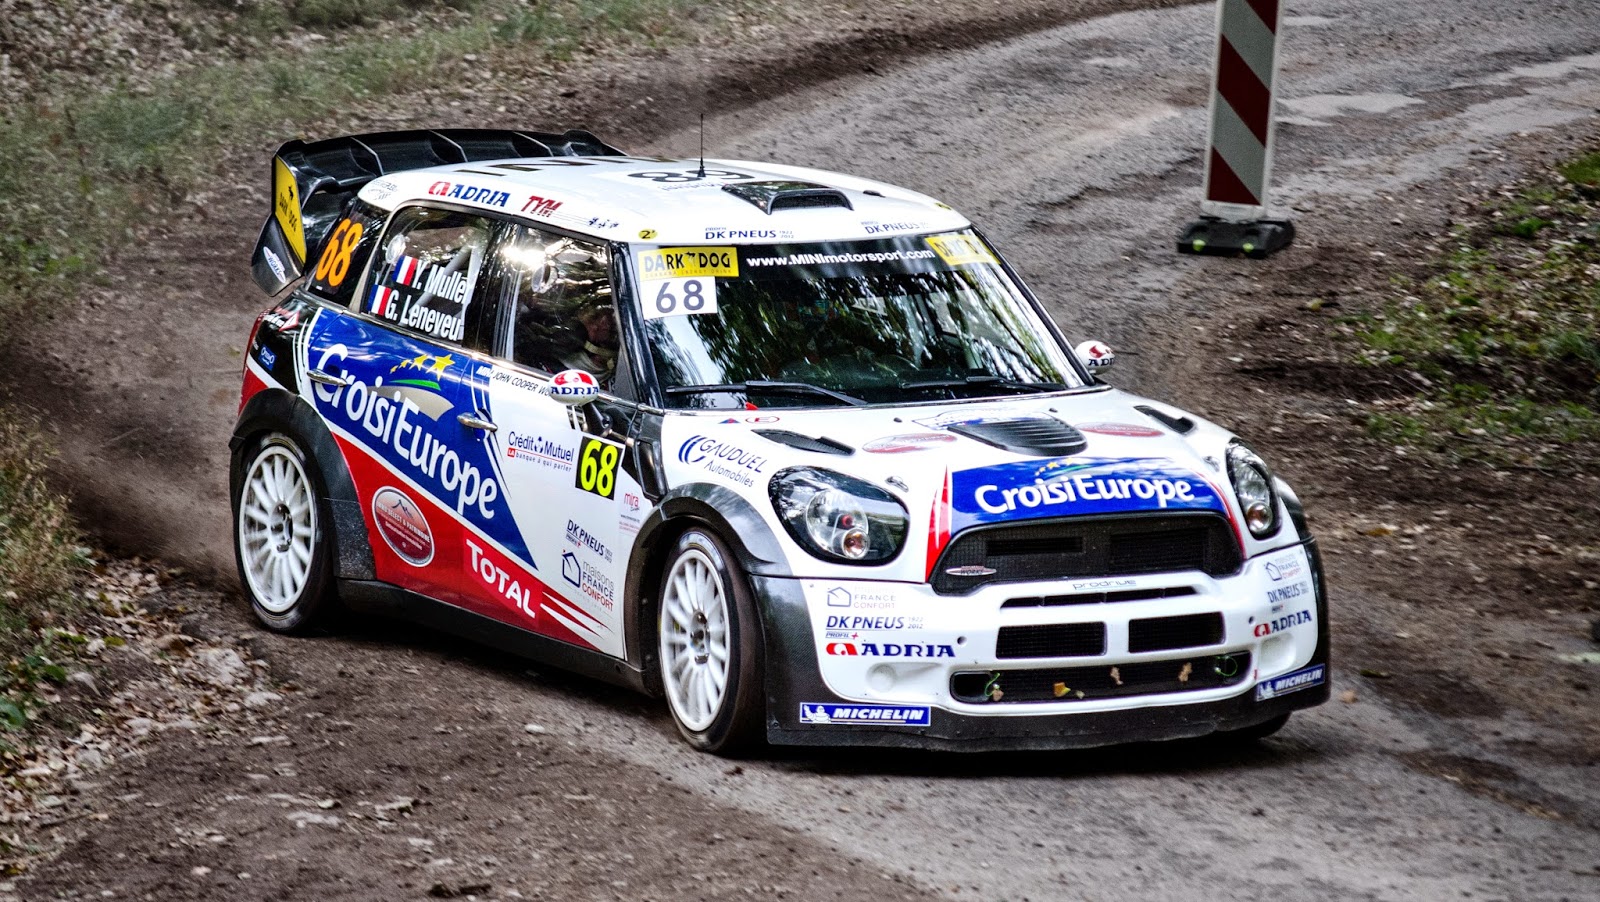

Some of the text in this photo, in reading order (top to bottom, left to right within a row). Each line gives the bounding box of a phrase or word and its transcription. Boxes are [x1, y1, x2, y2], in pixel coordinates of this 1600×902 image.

[447, 184, 511, 207] ADRIA
[521, 195, 563, 214] TYM
[705, 230, 776, 240] DK PNEUS
[864, 225, 884, 234] DK
[882, 221, 920, 231] PNEUS
[316, 218, 363, 287] 68
[644, 252, 731, 273] DARK DOG
[746, 249, 935, 267] www.MINImotorsport.com
[412, 260, 428, 290] Y.
[656, 279, 705, 313] 68
[385, 289, 464, 341] G. Leneveu
[493, 371, 512, 383] JOHN
[511, 377, 539, 392] COOPER
[551, 386, 600, 395] ADRIA
[313, 343, 499, 519] CroisiEurope
[508, 431, 575, 462] Crédit Mutuel
[700, 439, 768, 473] GAUDUEL
[516, 452, 536, 463] banque
[553, 463, 572, 472] parler
[580, 439, 618, 497] 68
[704, 459, 755, 488] Automobiles
[974, 473, 1195, 514] CroisiEurope
[567, 519, 580, 536] DK
[579, 527, 605, 556] PNEUS
[466, 539, 536, 619] TOTAL
[582, 571, 614, 601] FRANCE
[583, 561, 614, 592] maisons
[1073, 579, 1137, 590] prodrive
[582, 582, 614, 612] CONFORT
[855, 594, 896, 602] FRANCE
[1267, 590, 1279, 603] DK
[1278, 584, 1301, 600] PNEUS
[826, 615, 905, 629] DK PNEUS
[1271, 609, 1312, 633] ADRIA
[861, 643, 956, 657] ADRIA
[1275, 669, 1323, 690] MICHELIN
[832, 708, 925, 720] MICHELIN
